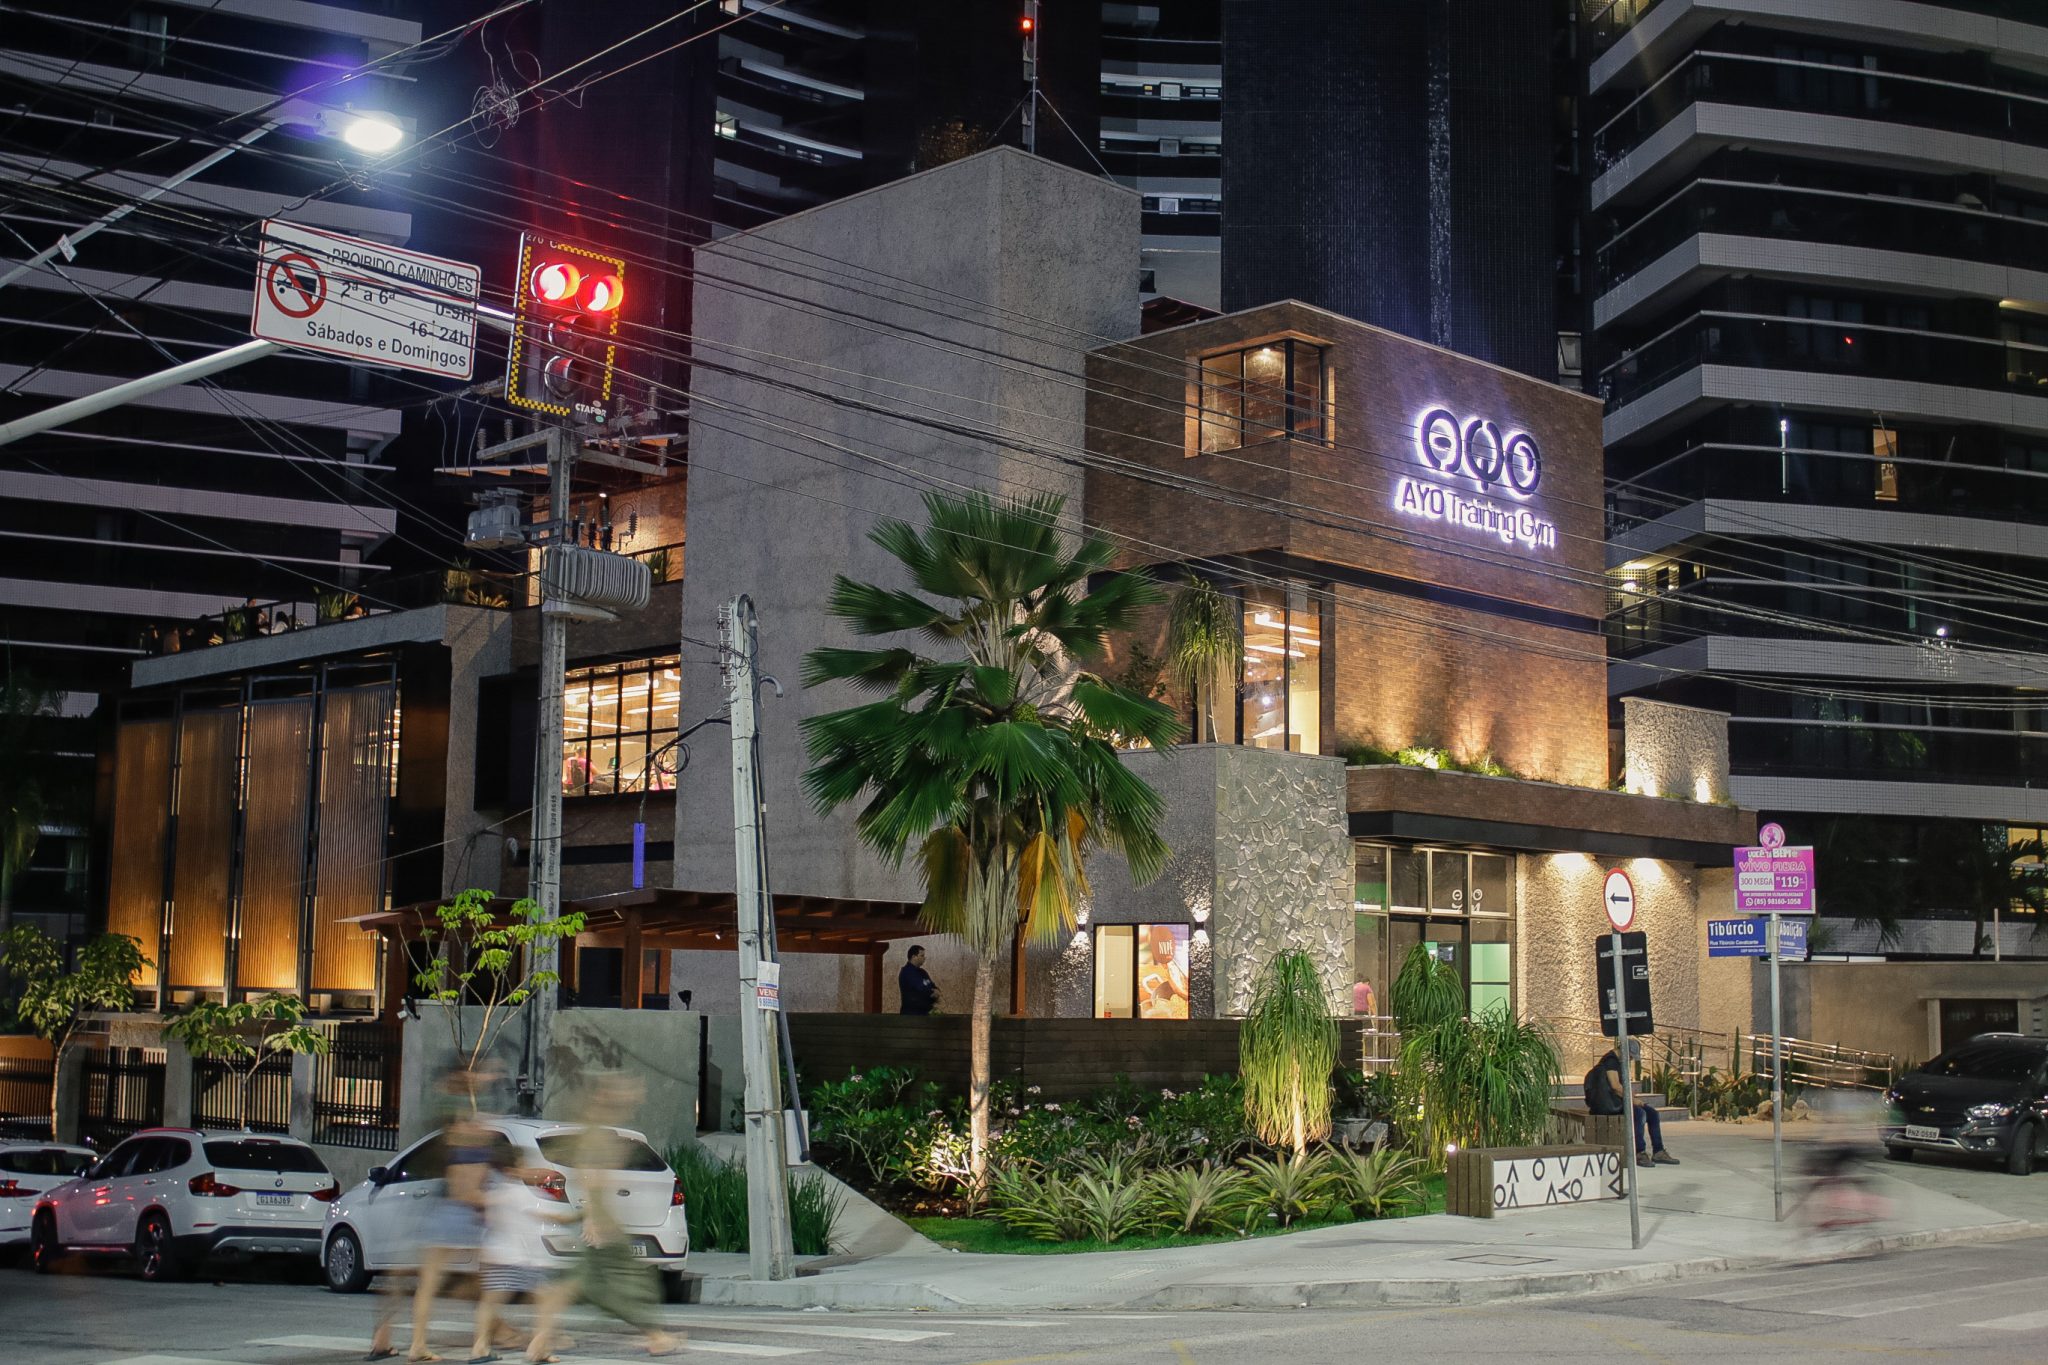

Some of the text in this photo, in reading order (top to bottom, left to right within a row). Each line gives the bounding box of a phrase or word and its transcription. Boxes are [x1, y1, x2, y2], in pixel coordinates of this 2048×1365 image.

[398, 262, 474, 293] CAMINHÕES
[363, 289, 373, 302] a
[306, 320, 466, 367] Sábados e Domingos
[1399, 480, 1558, 549] AYO Training Gym
[1781, 876, 1799, 888] 119
[1708, 921, 1754, 937] Tibúrcio
